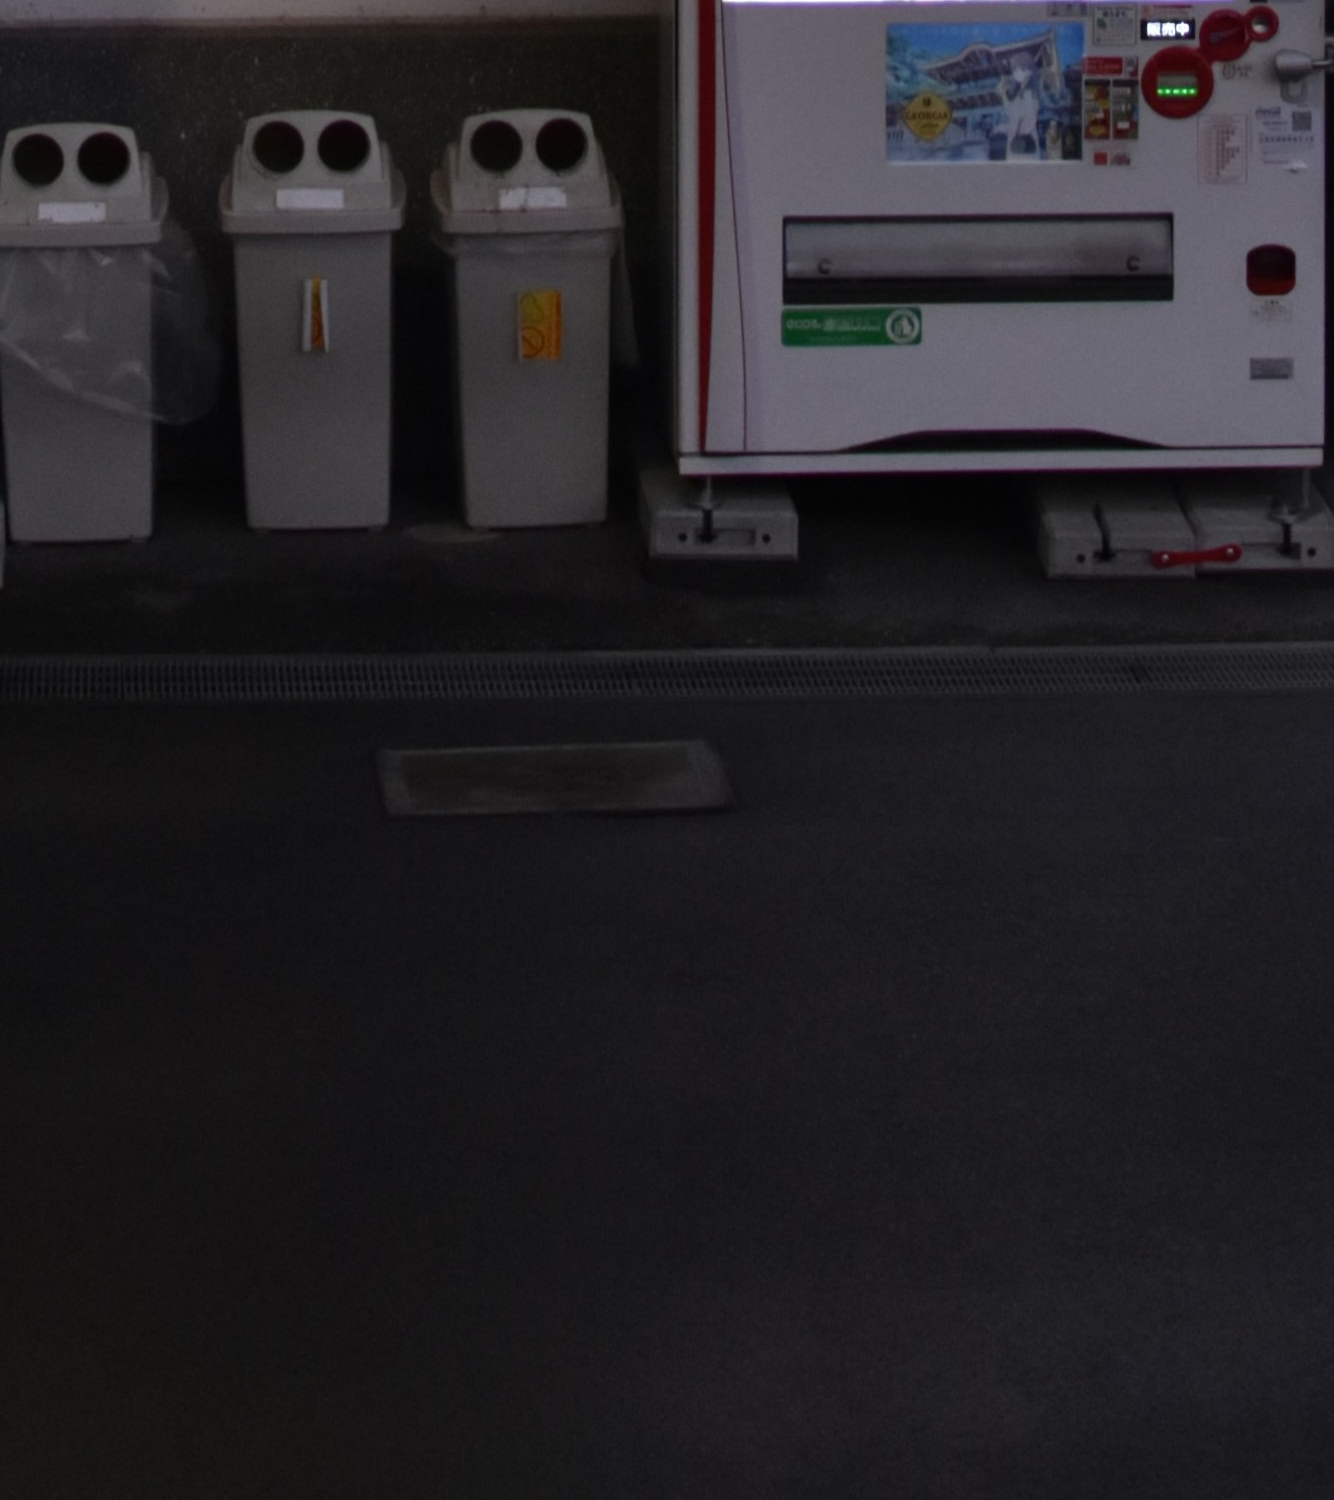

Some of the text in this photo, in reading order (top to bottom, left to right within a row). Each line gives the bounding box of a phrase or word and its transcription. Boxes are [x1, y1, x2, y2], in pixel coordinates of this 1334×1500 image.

[1147, 21, 1190, 37] 販売中
[905, 110, 948, 120] GEORGIA
